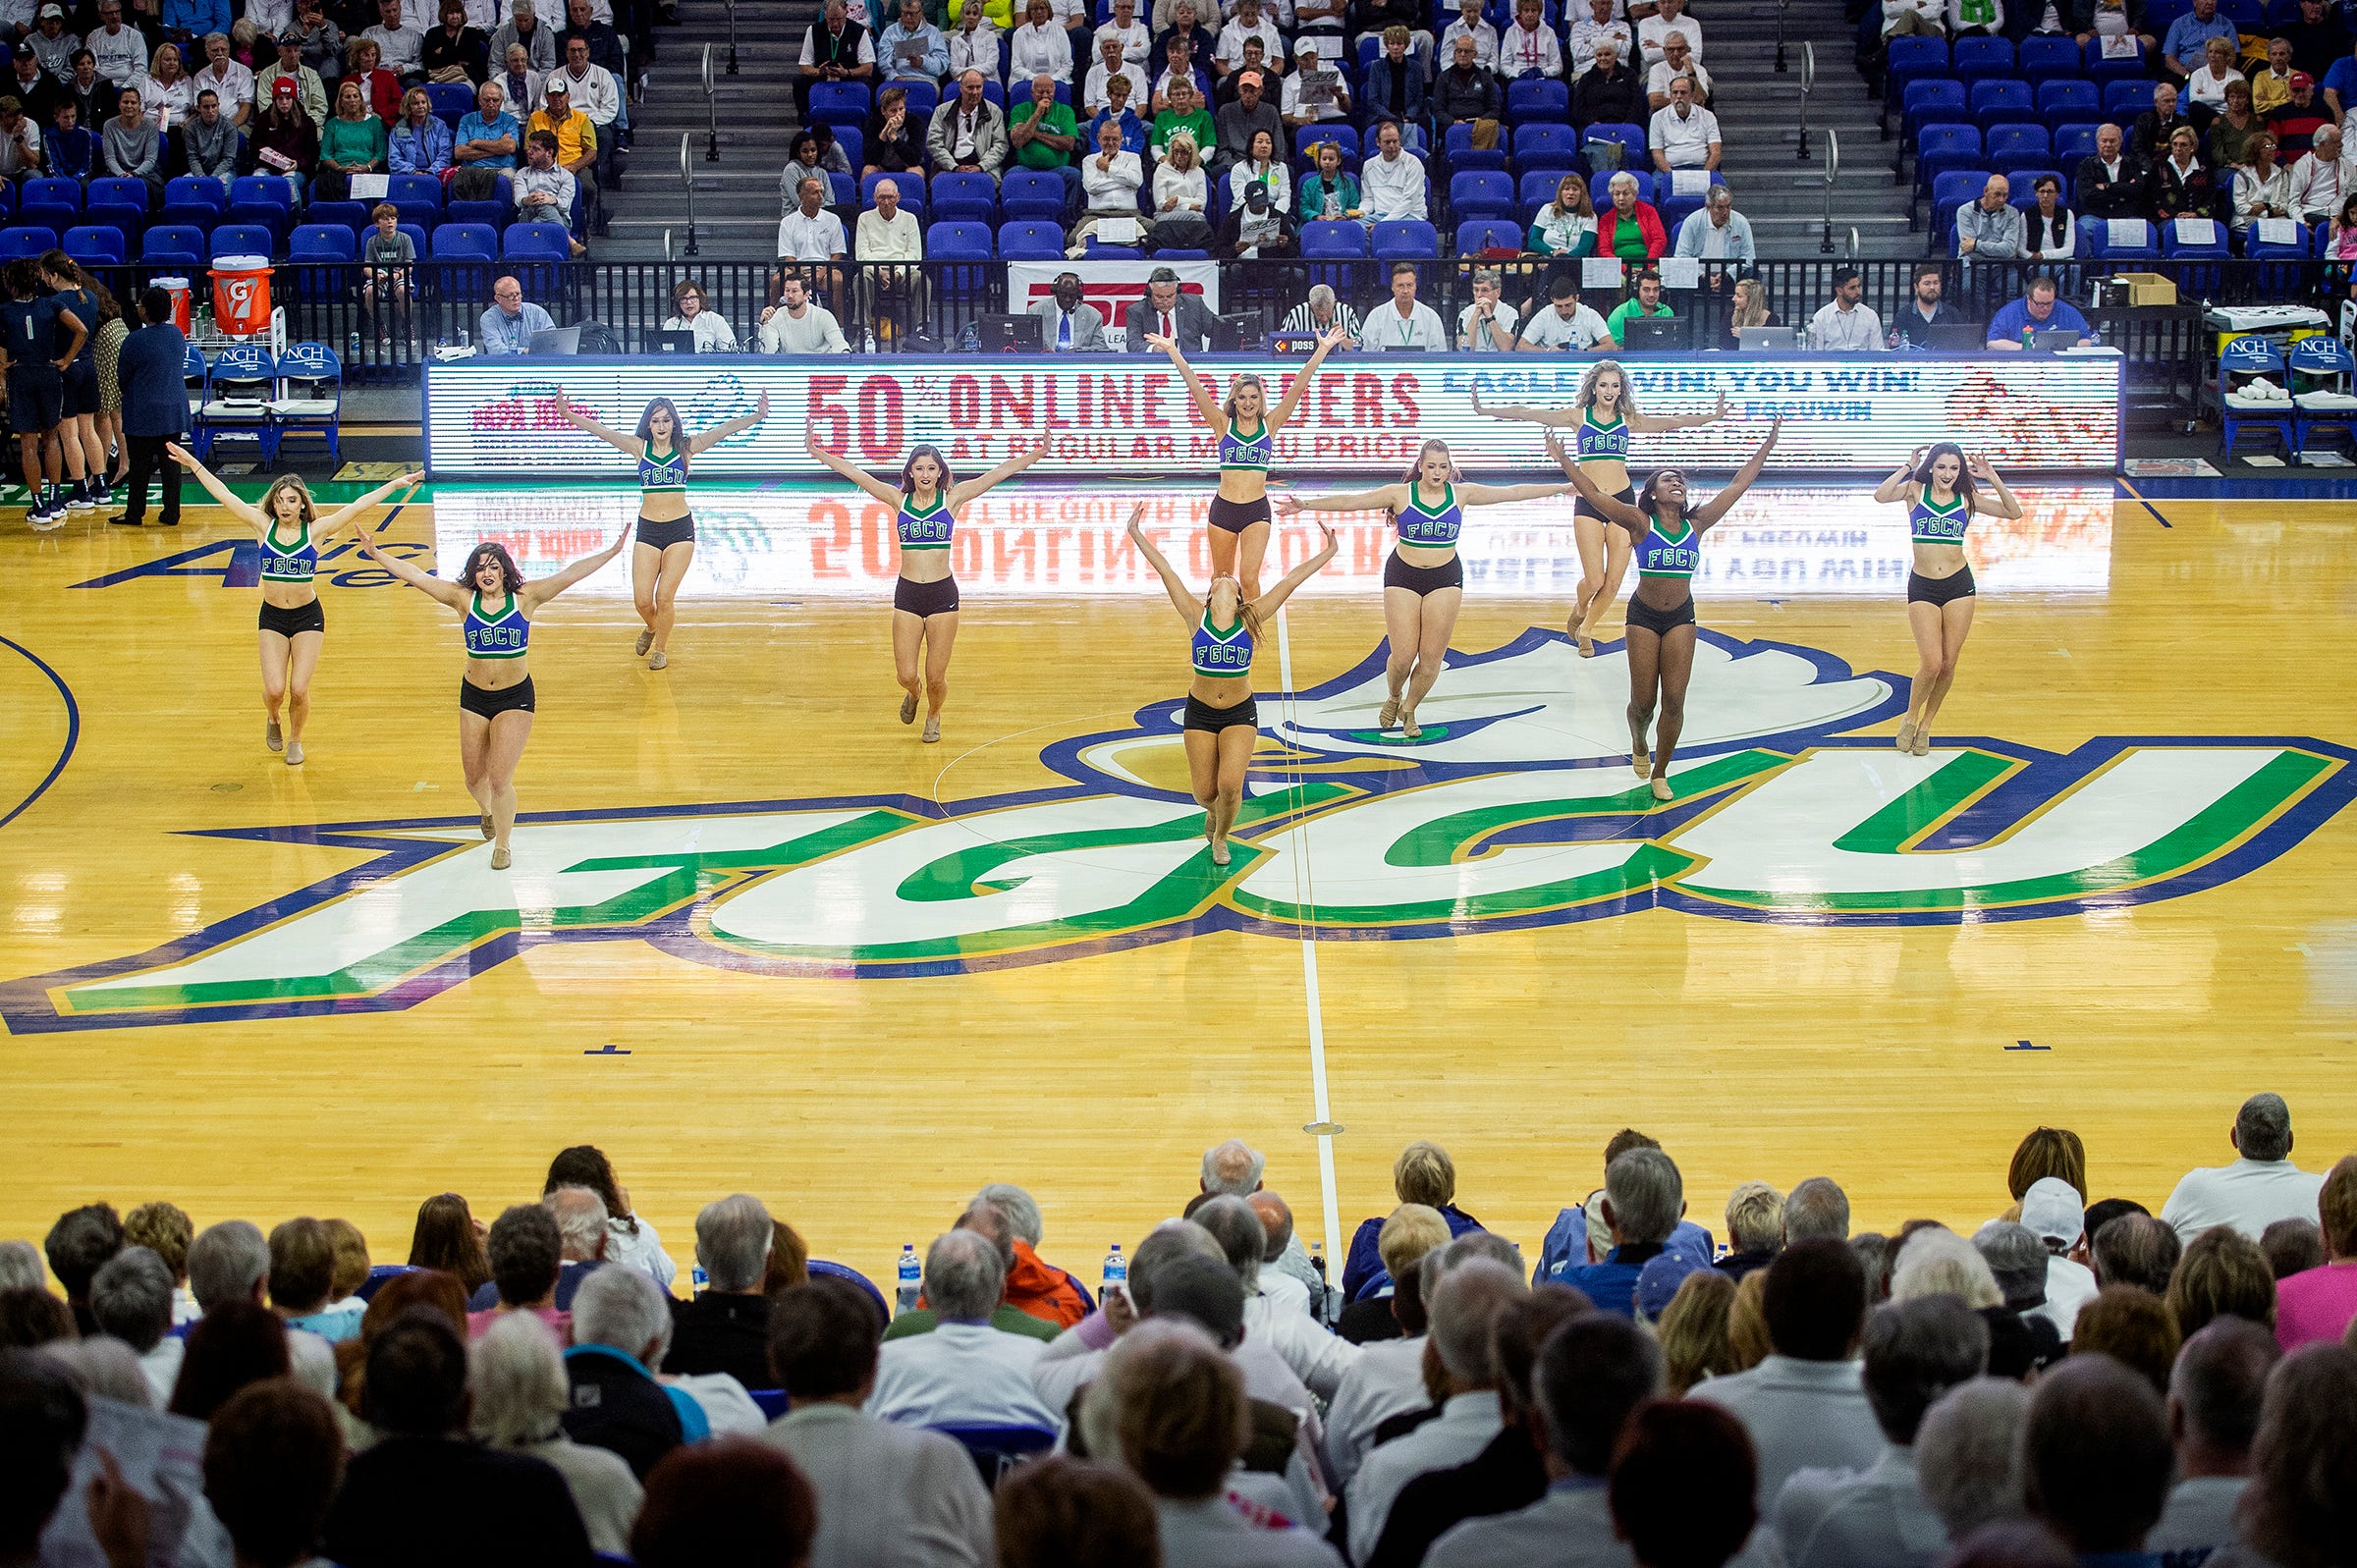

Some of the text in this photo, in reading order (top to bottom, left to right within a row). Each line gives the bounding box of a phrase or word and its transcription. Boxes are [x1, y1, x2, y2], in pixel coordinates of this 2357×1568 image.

[1166, 126, 1195, 136] FGCU
[230, 282, 247, 300] G
[26, 315, 34, 340] 1
[1108, 335, 1126, 344] LEA
[2230, 340, 2268, 353] NCH
[2300, 340, 2337, 353] NCH
[221, 349, 258, 362] NCH
[287, 347, 324, 359] NCH
[1443, 370, 1580, 393] EAGLE
[1726, 370, 1813, 393] YOU
[949, 374, 1170, 430] ONLINE
[1186, 374, 1422, 429] ODERS
[1314, 433, 1421, 461] PRICE
[1582, 434, 1628, 454] FGCU
[1225, 446, 1270, 464] FGCU
[642, 467, 685, 486] FGCU
[899, 520, 948, 542] FGCU
[1406, 521, 1459, 539] FGCU
[1916, 516, 1963, 538] FGCU
[262, 558, 312, 575] FGCU
[1648, 548, 1699, 569] FGCU
[468, 626, 521, 649] FGCU
[1196, 644, 1249, 666] FGCU
[3, 734, 2357, 1034] FGCU
